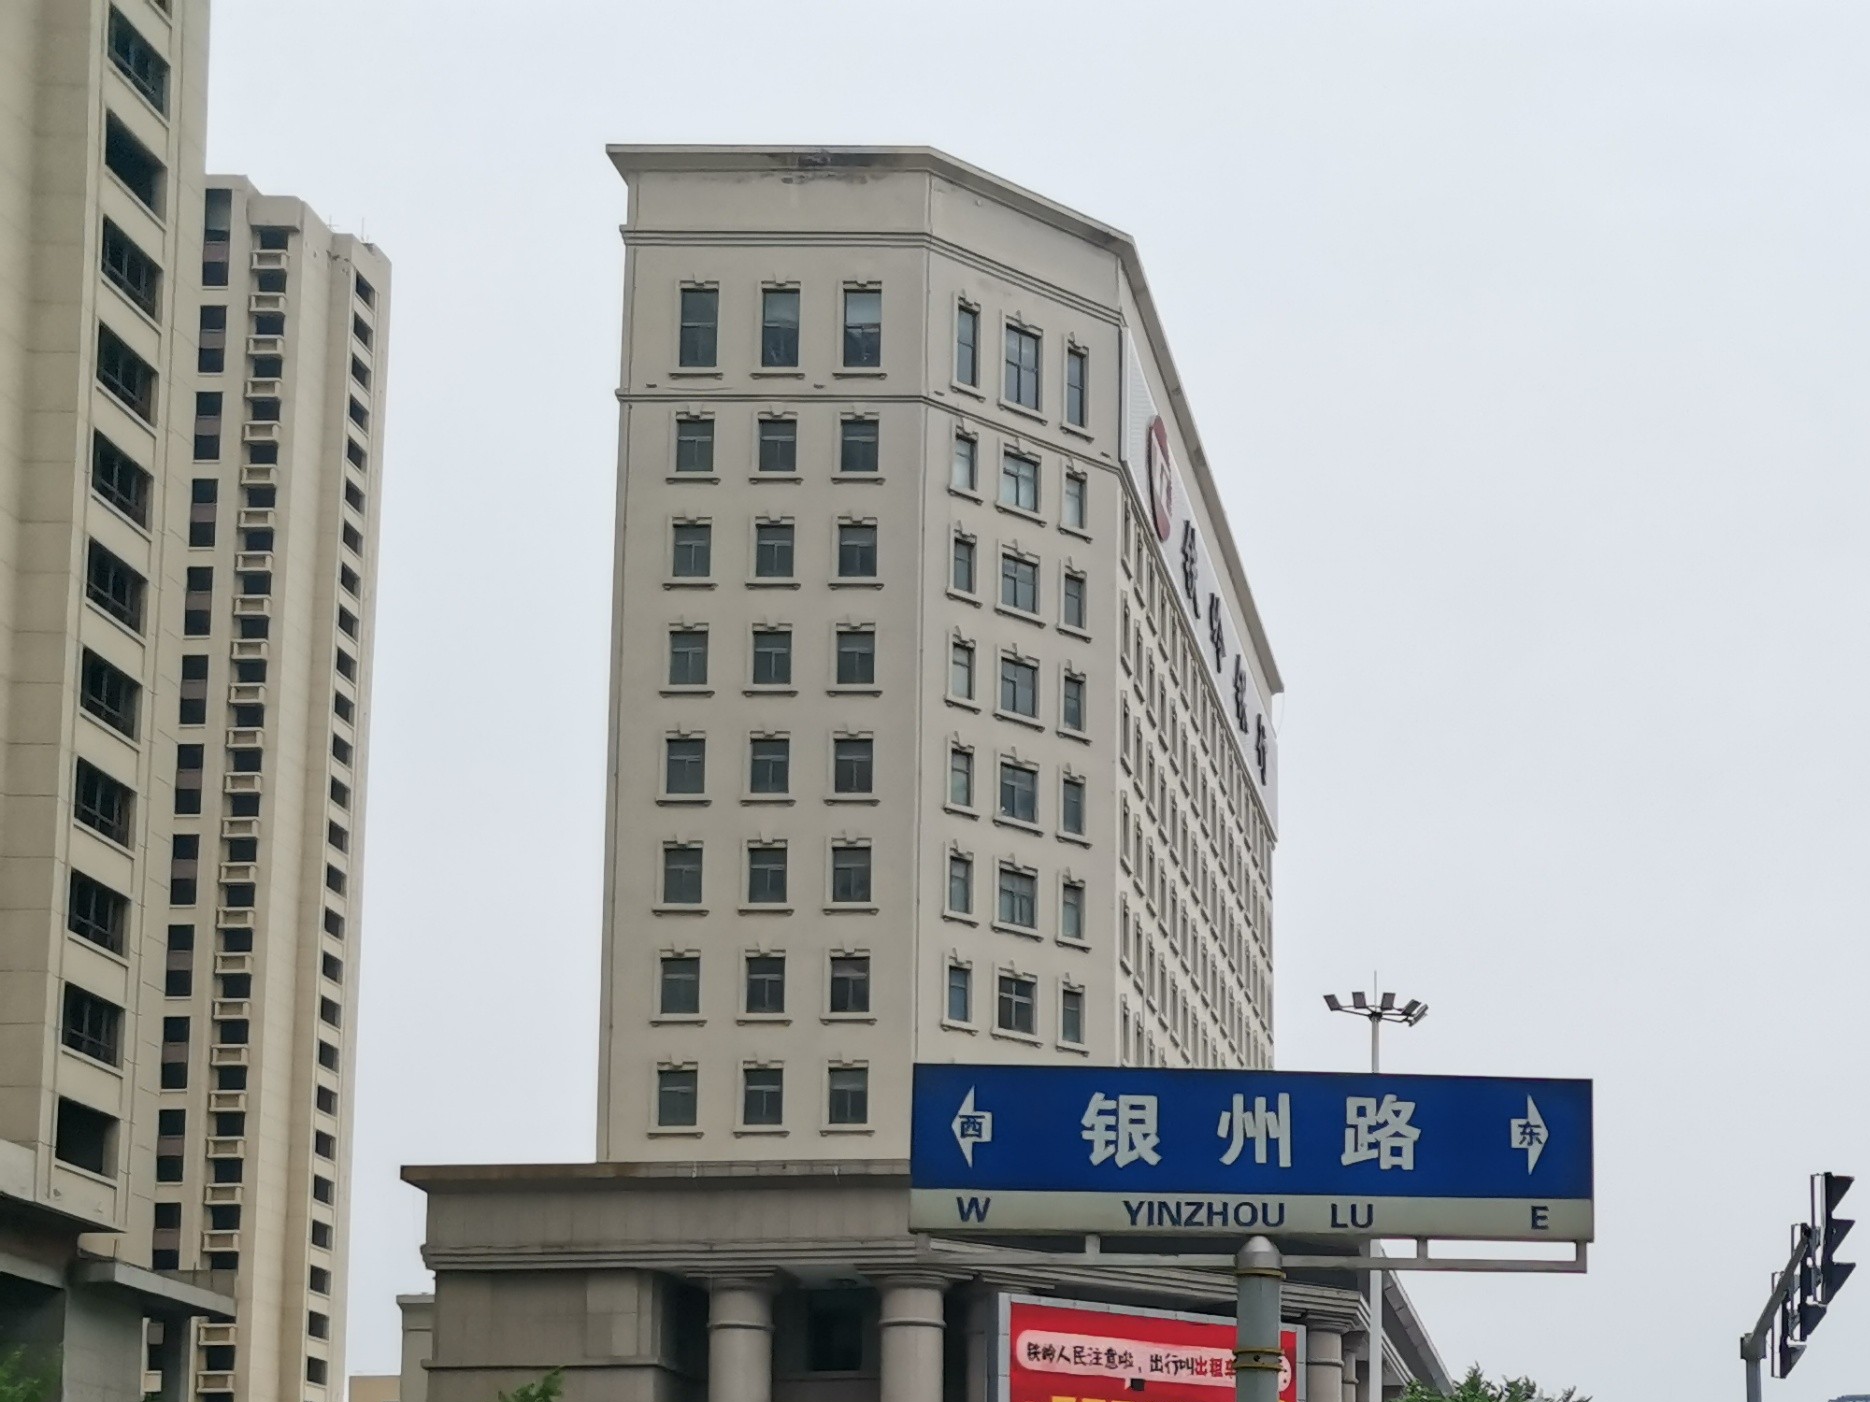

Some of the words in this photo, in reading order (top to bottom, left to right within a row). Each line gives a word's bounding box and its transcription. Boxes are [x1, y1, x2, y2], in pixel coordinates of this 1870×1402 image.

[958, 1114, 986, 1139] 西
[1080, 1092, 1422, 1171] 银州路
[1517, 1121, 1543, 1146] 东
[956, 1196, 991, 1222] W
[1123, 1200, 1286, 1228] YINZHOU
[1330, 1203, 1375, 1230] LU
[1530, 1205, 1549, 1230] E
